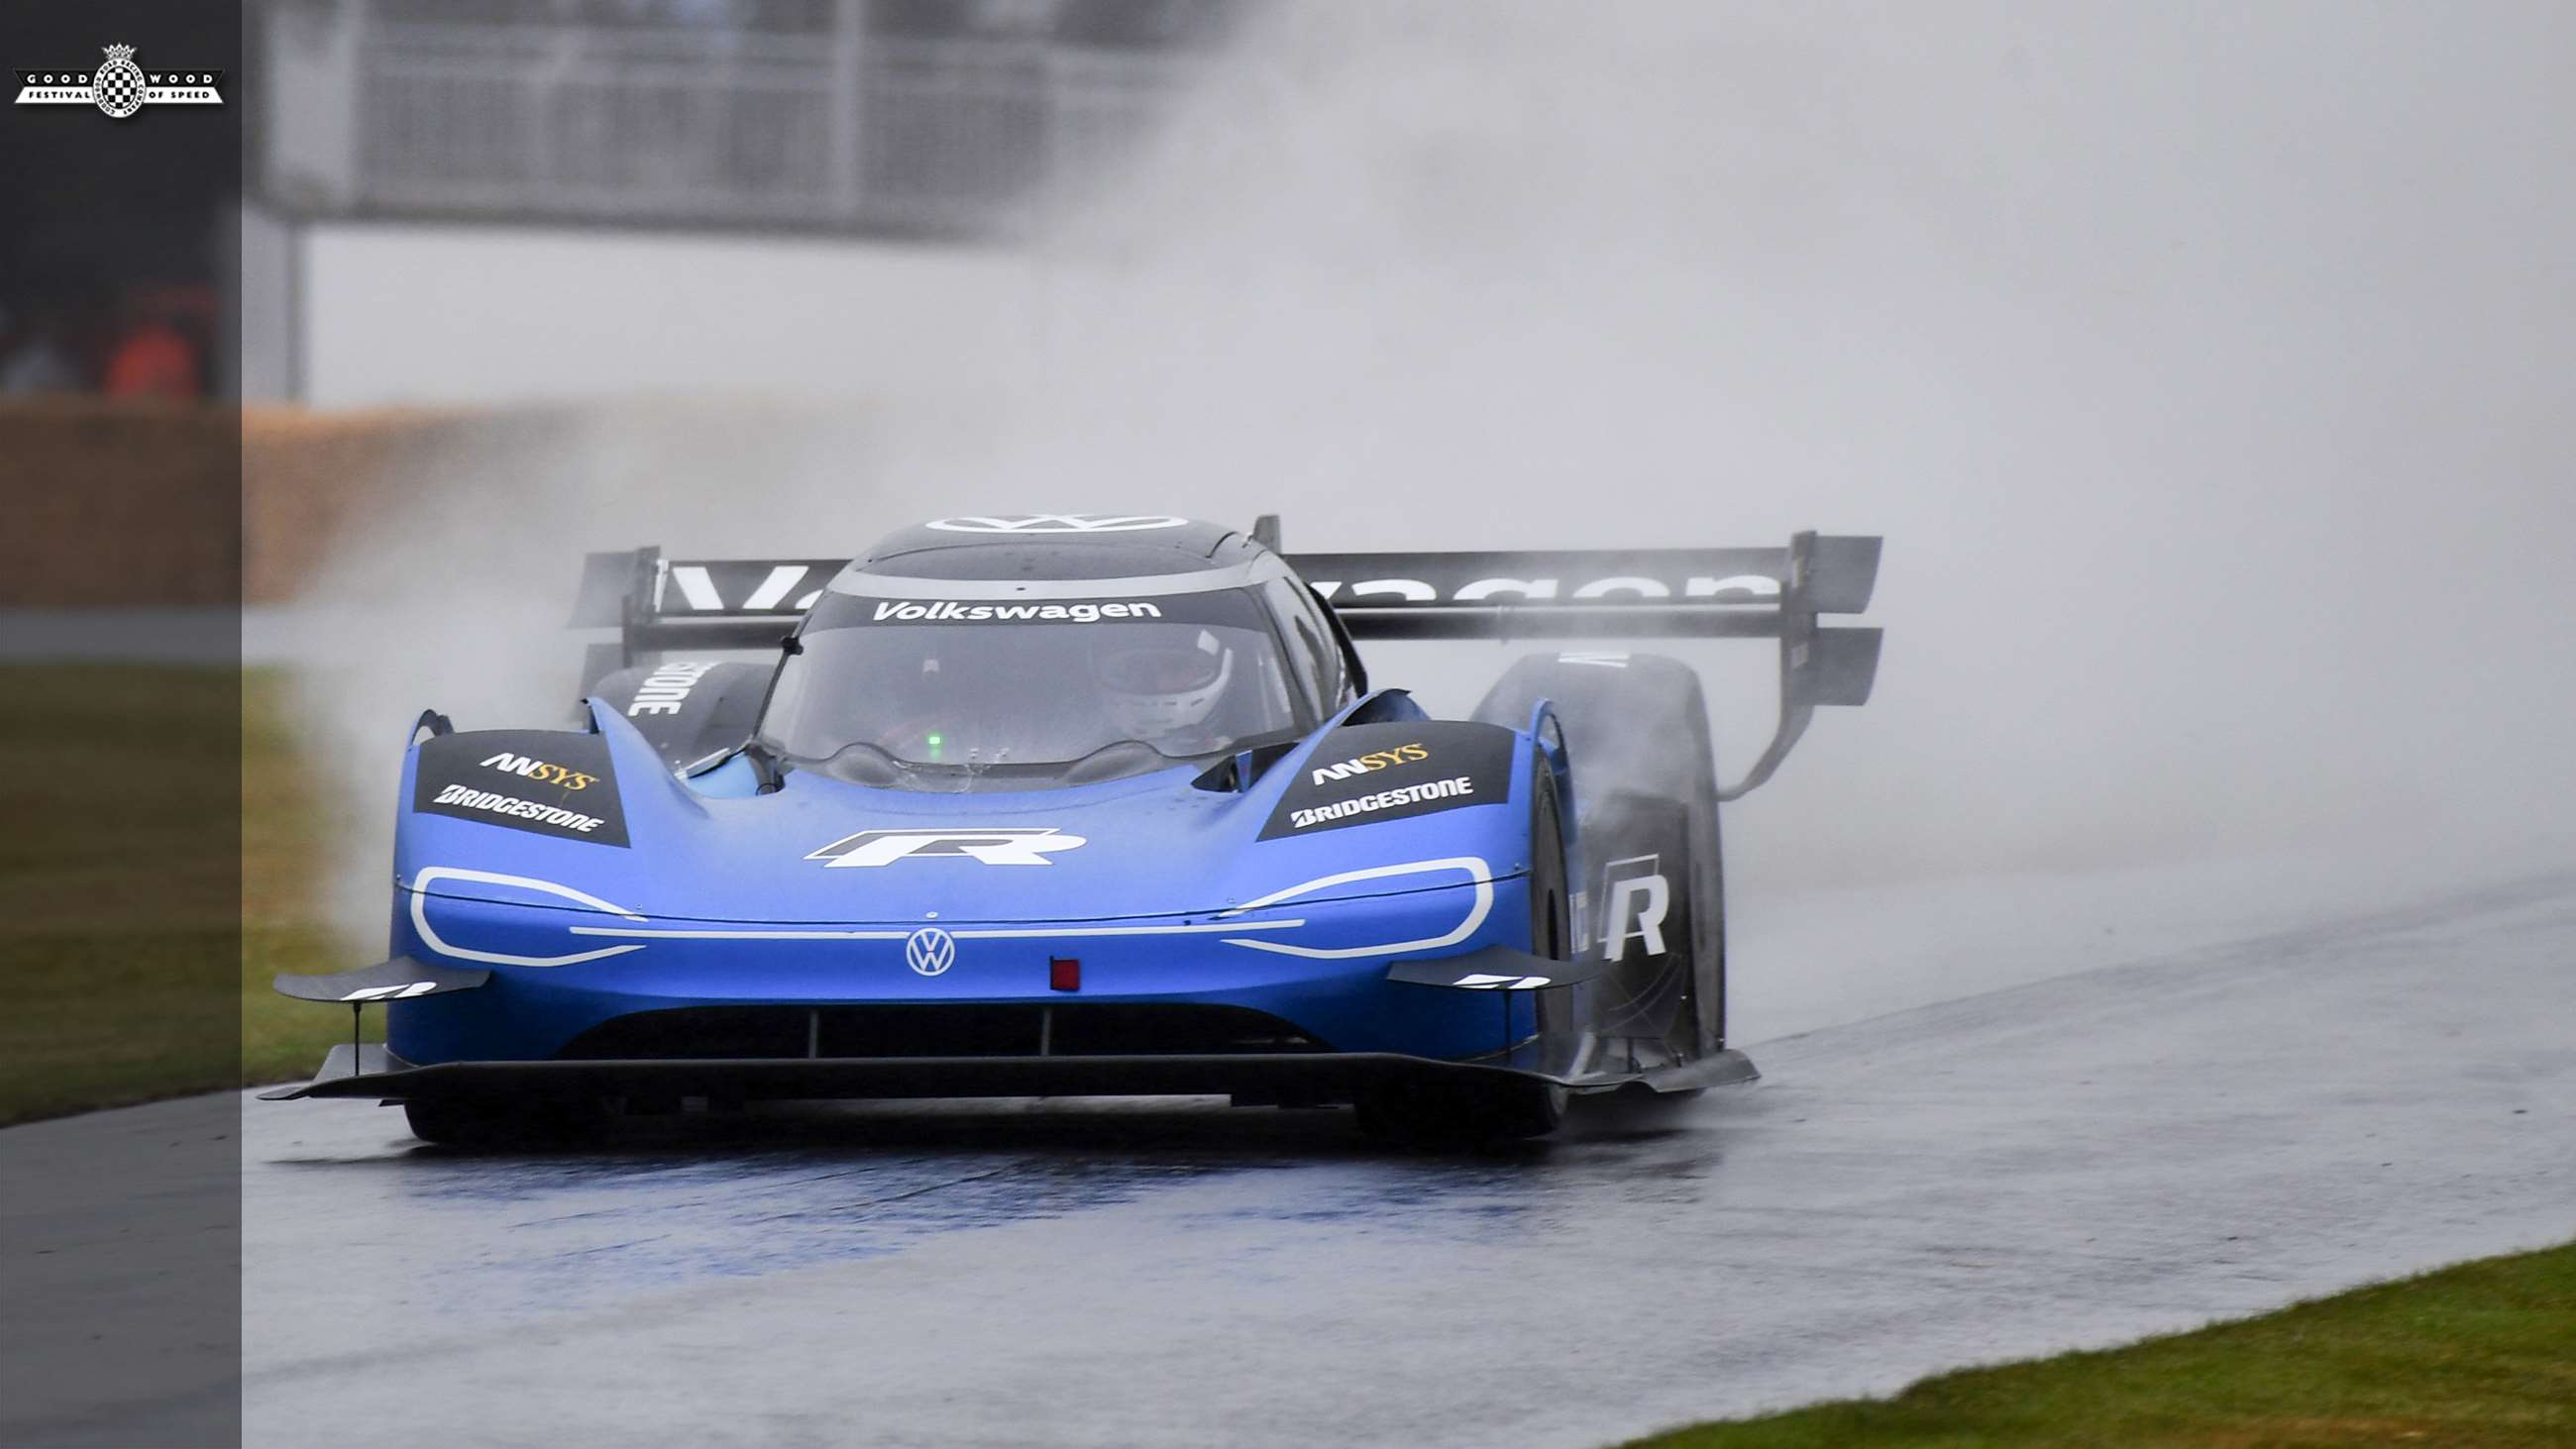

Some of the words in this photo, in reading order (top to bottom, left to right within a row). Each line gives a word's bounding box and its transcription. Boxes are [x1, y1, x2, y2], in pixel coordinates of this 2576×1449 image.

[872, 600, 1162, 623] Volkswagen
[480, 752, 600, 790] ANSYS
[1312, 743, 1429, 785] ANSYS
[433, 783, 605, 833] BRIDGESTONE
[1290, 776, 1474, 828] BRIDGESTONE
[803, 828, 1087, 868] R
[1598, 855, 1669, 962] R
